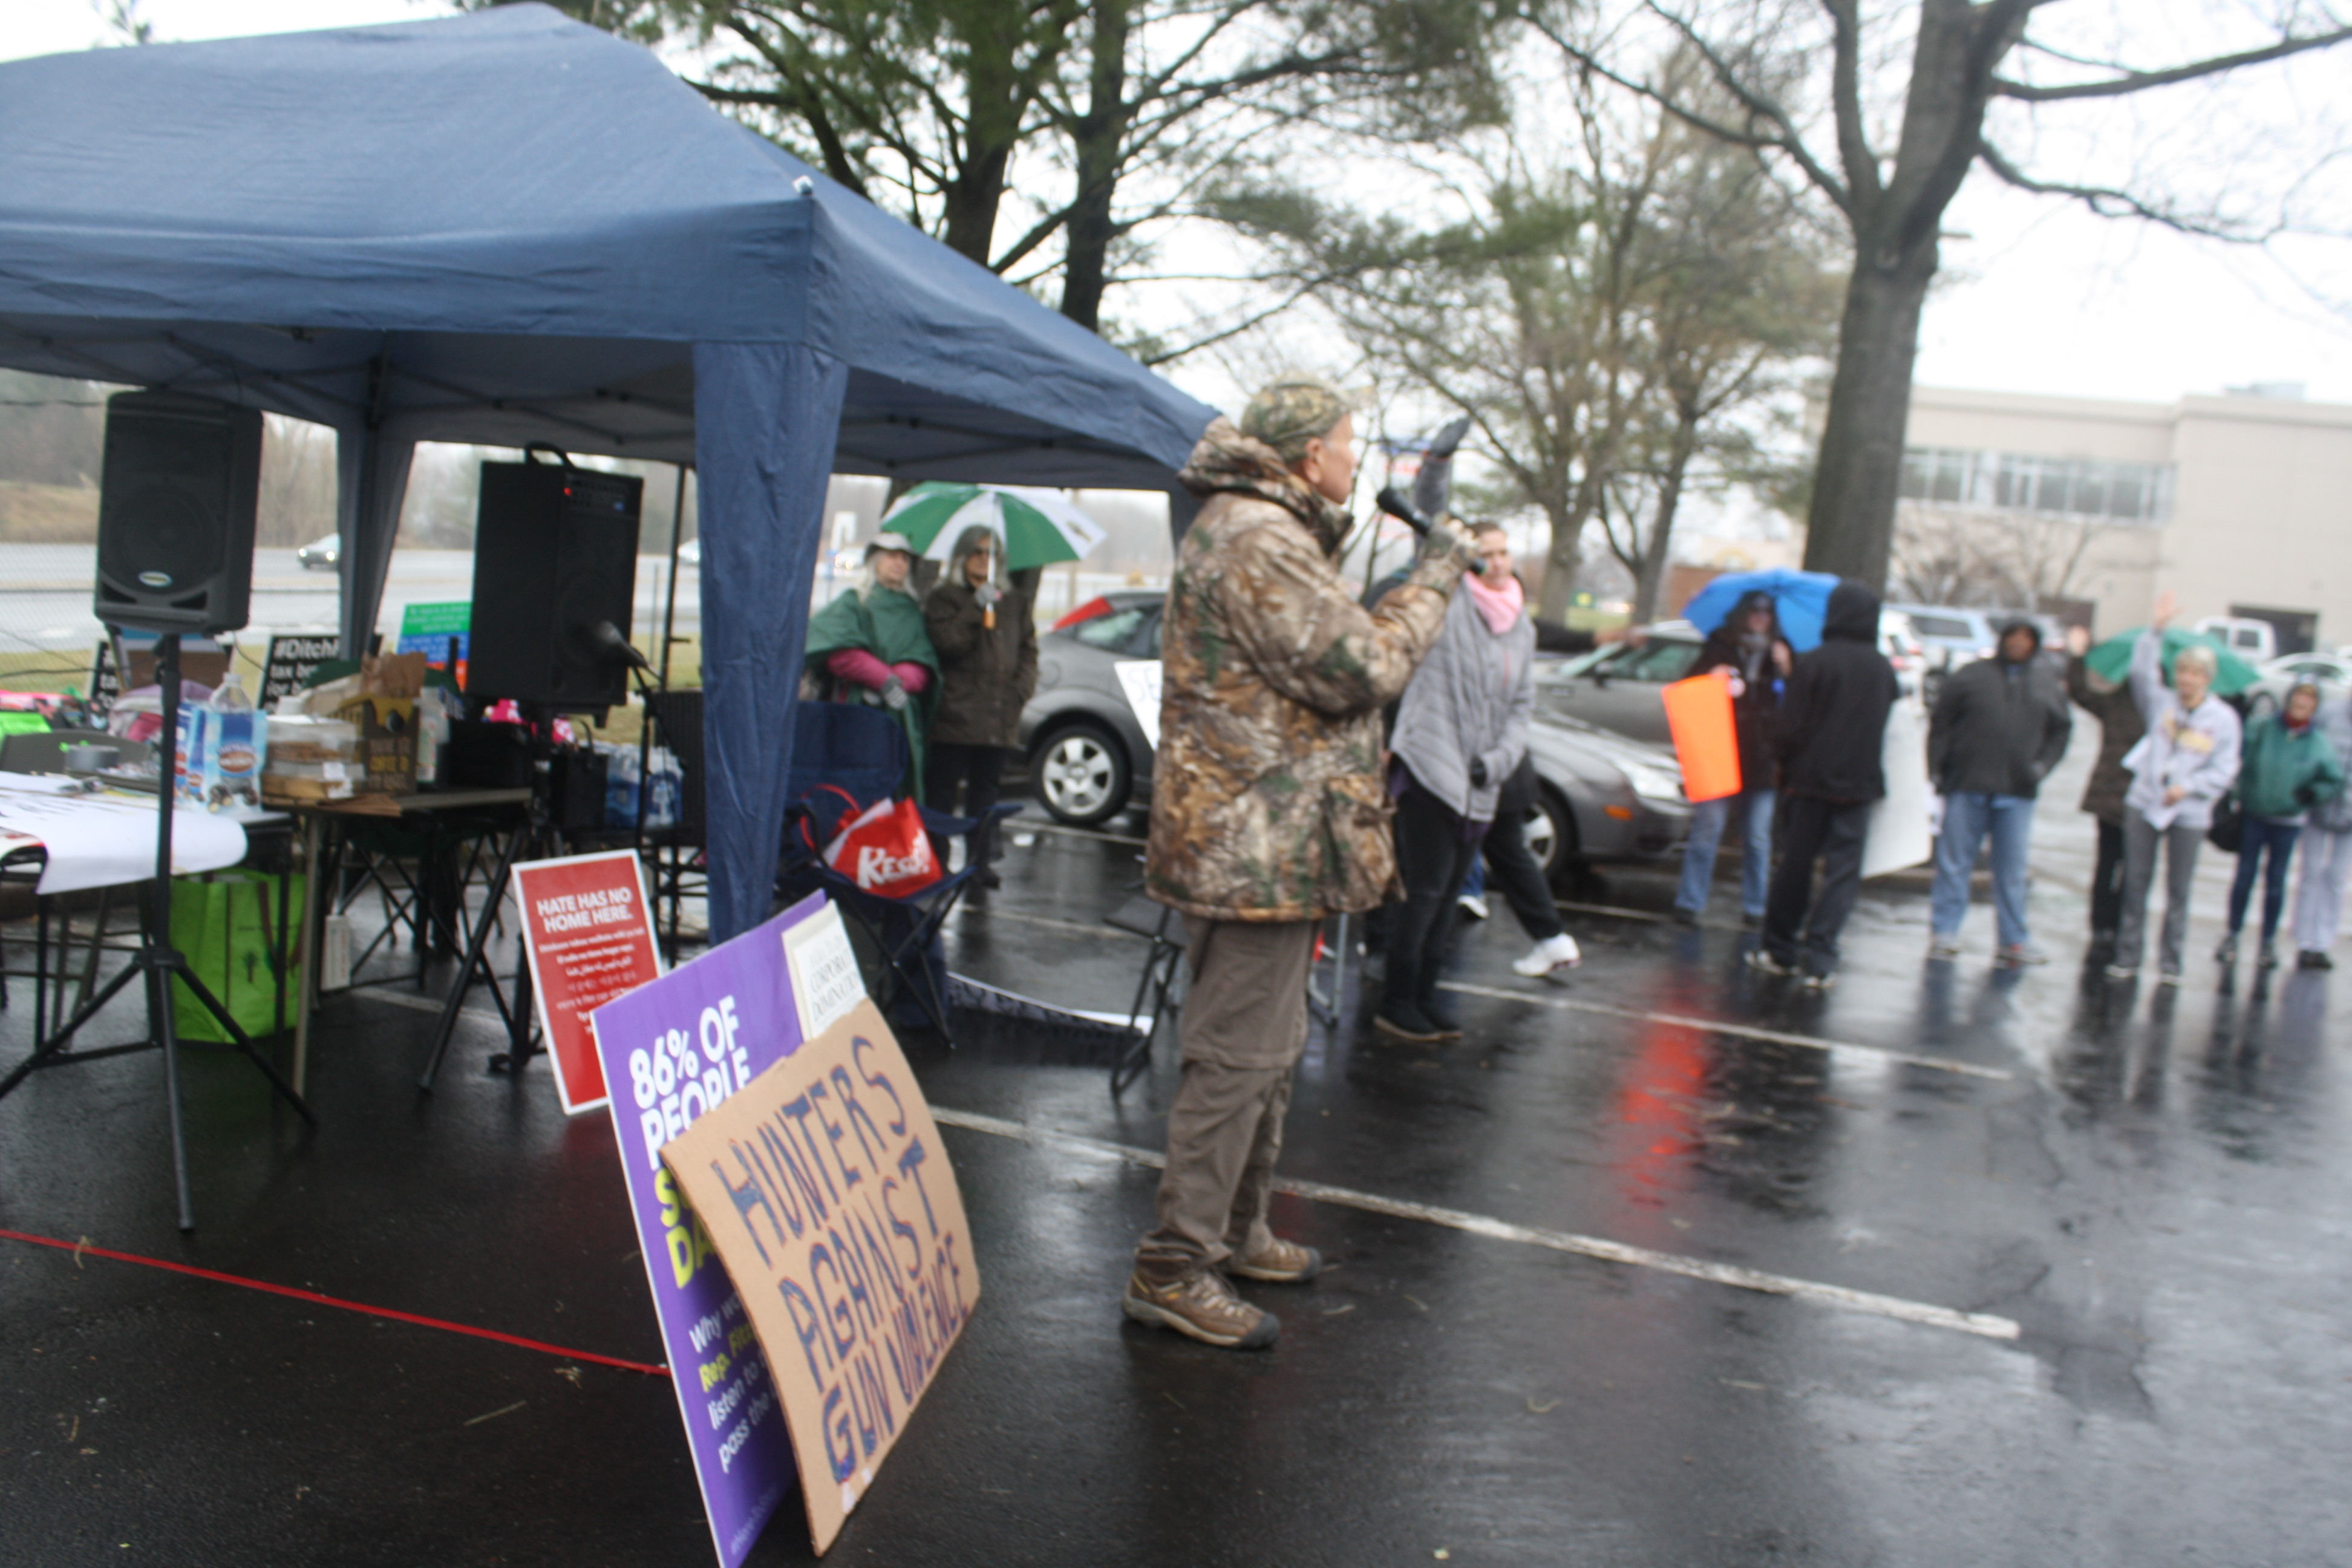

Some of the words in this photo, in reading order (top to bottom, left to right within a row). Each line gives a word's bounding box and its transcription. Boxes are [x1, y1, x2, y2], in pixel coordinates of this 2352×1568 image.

[536, 894, 576, 916] HATE
[577, 890, 608, 910] HAS
[607, 886, 633, 905] NO
[544, 910, 592, 934] HOME
[591, 905, 634, 926] HERE.
[629, 1028, 699, 1110] 86%
[699, 995, 739, 1063] OF
[711, 1035, 907, 1270] HUNTERS
[779, 1135, 938, 1394] AGAINST
[688, 1309, 722, 1354] Why
[884, 1230, 968, 1405] VIOLENCE
[698, 1351, 731, 1393] Rep.
[707, 1377, 746, 1431] listen
[742, 1360, 759, 1387] to
[823, 1340, 894, 1485] GUN
[719, 1417, 750, 1474] pass
[748, 1391, 771, 1428] the
